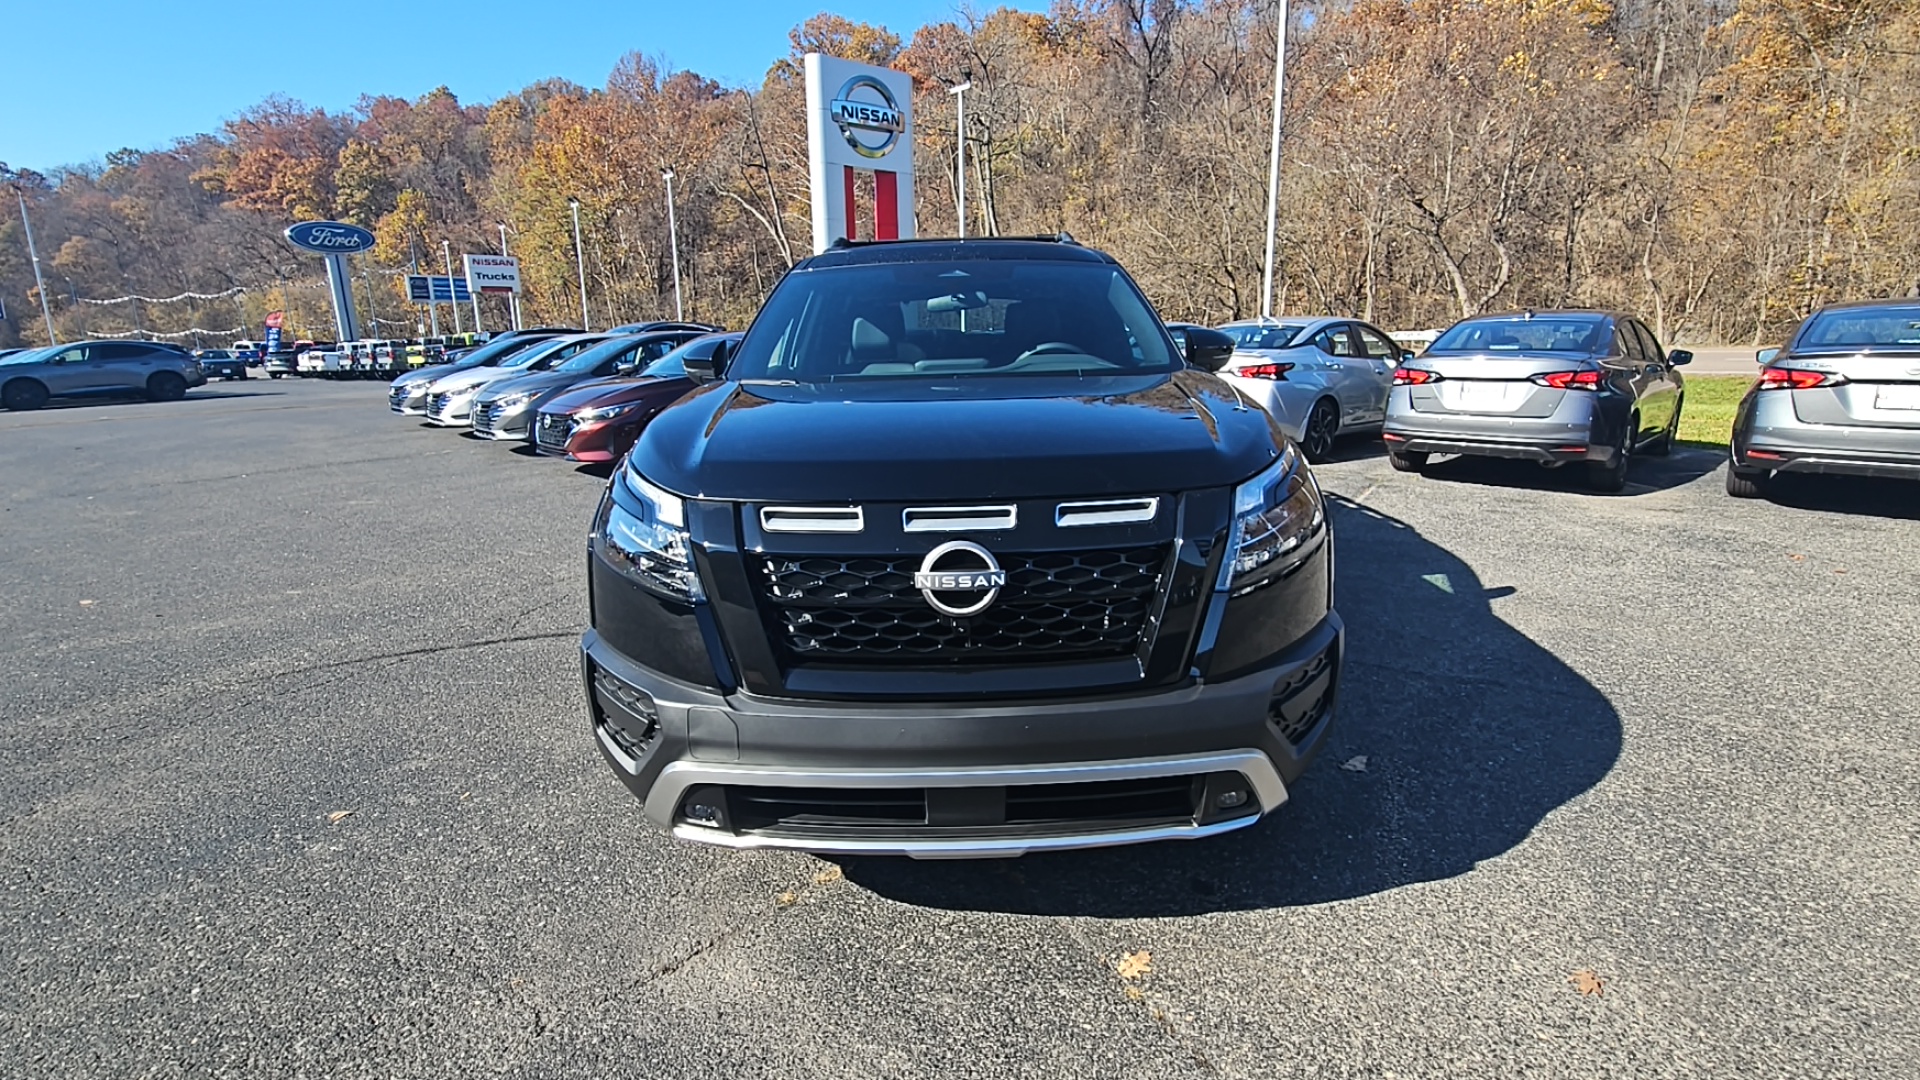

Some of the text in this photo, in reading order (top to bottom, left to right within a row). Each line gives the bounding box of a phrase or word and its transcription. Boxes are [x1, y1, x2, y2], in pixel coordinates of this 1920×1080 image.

[841, 104, 900, 127] NISSAN
[308, 226, 361, 246] Ford
[472, 258, 514, 267] NISSAN
[474, 272, 515, 281] Trucks
[917, 574, 1005, 588] NISSAN
